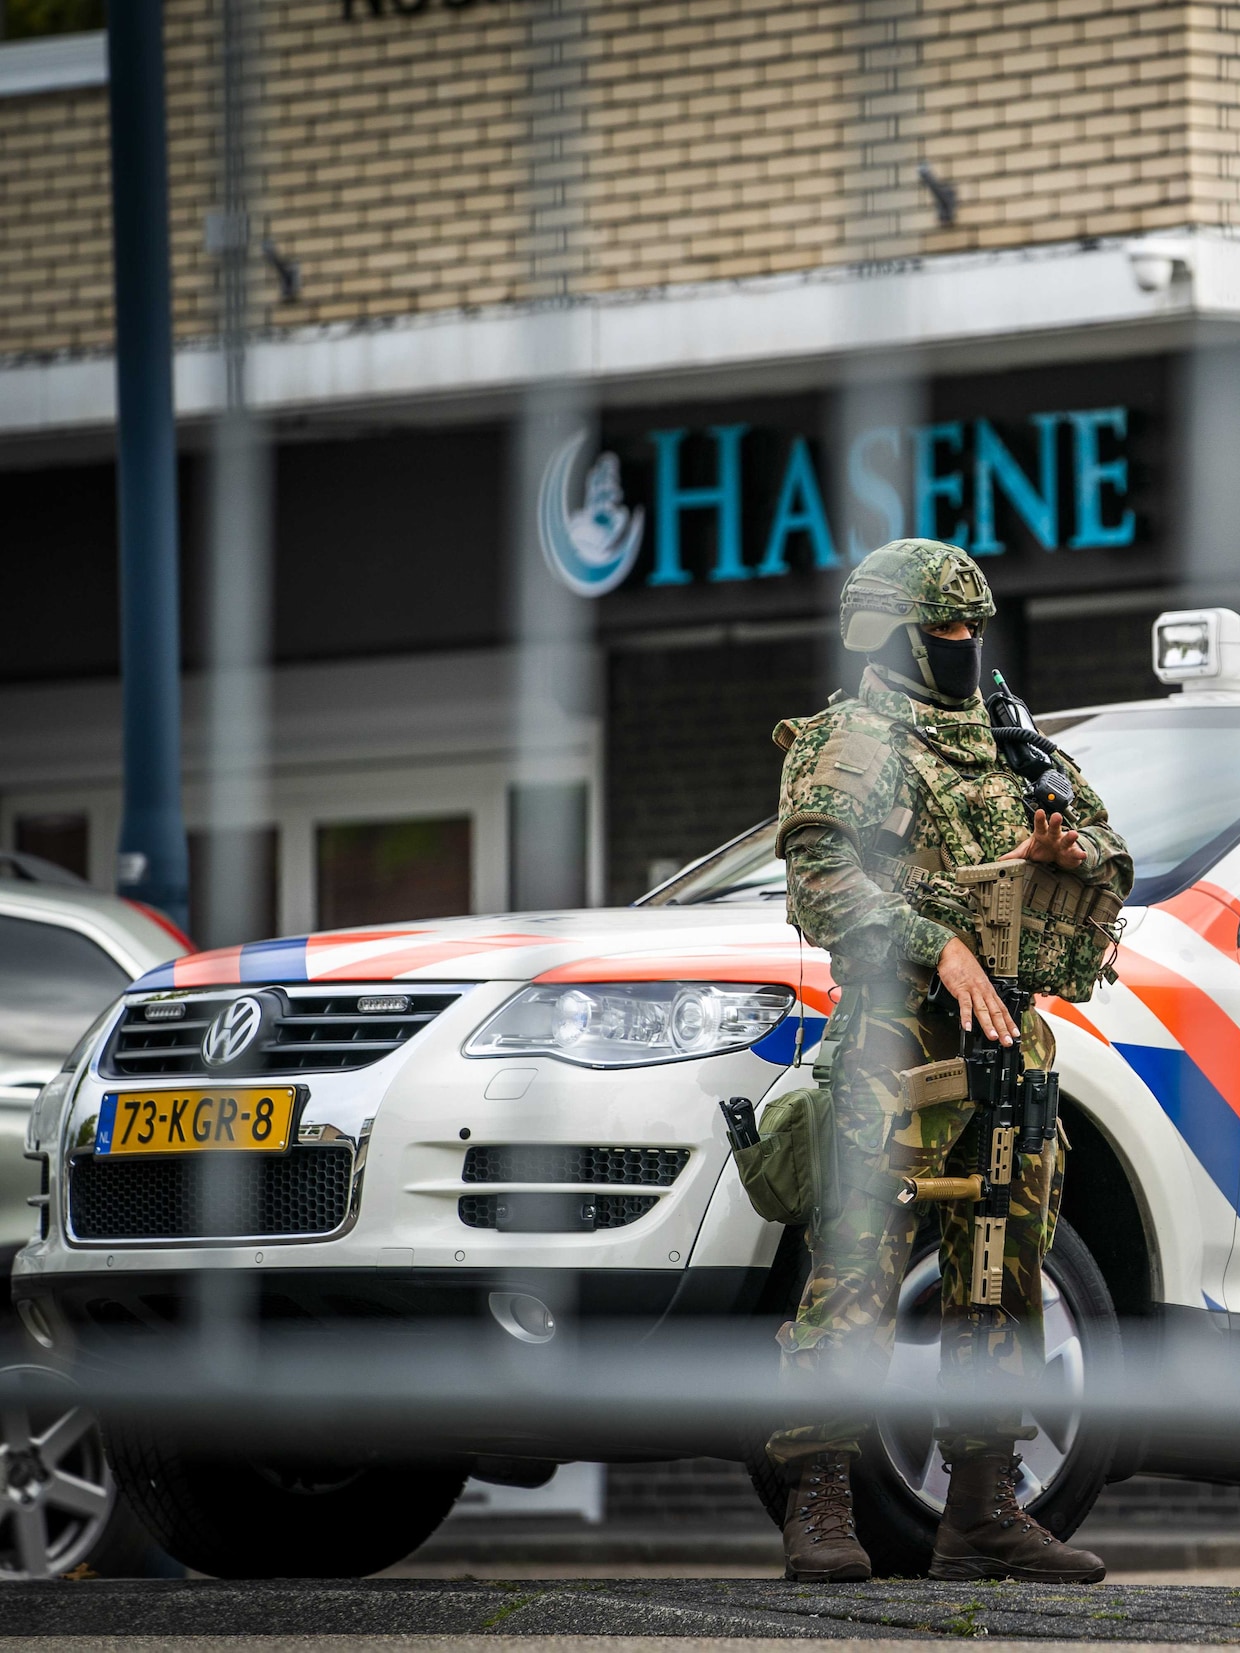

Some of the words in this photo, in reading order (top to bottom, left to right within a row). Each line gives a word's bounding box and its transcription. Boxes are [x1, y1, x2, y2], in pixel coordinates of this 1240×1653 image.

[648, 406, 1135, 586] HASENE
[98, 1131, 111, 1144] NL
[120, 1096, 275, 1145] 73-KGR-8
